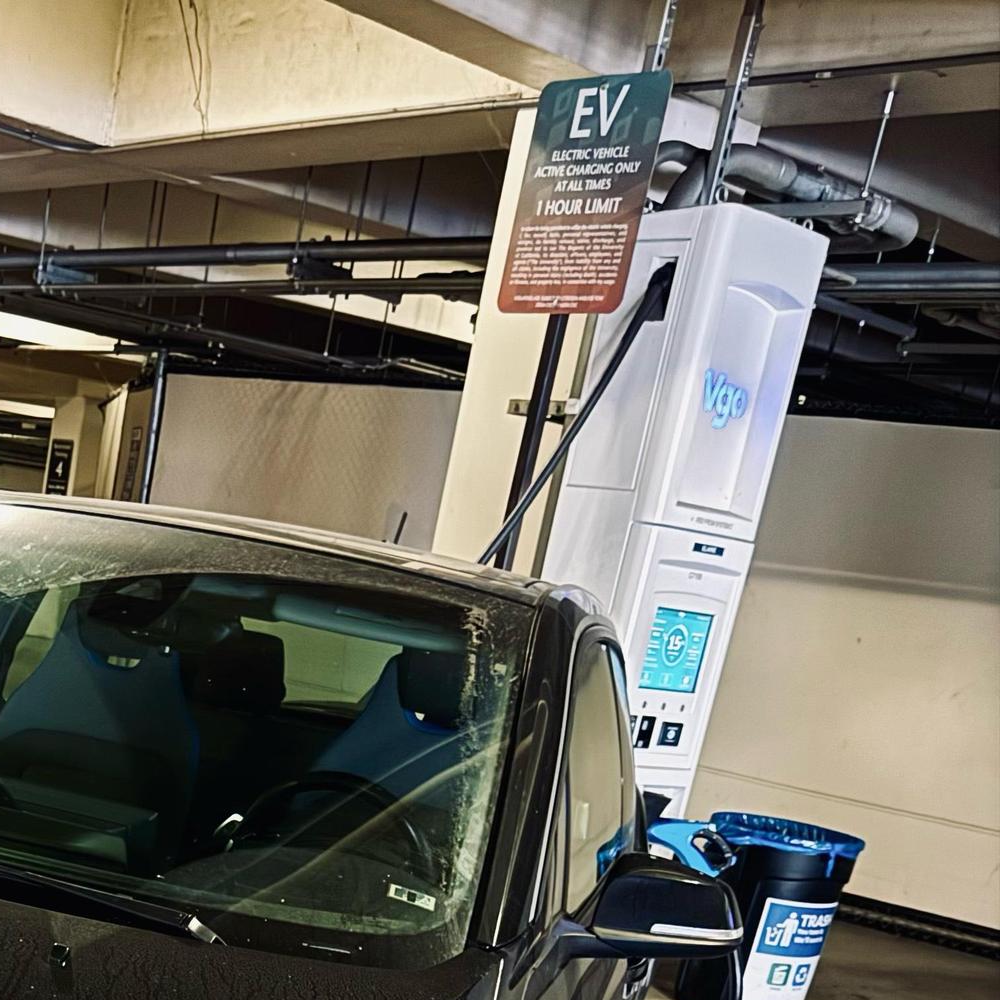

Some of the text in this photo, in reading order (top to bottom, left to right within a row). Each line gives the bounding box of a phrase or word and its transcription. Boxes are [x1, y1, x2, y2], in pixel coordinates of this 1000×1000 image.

[569, 84, 631, 139] EV
[551, 145, 630, 162] ELECTRIC VEHICLE
[534, 160, 642, 178] ACTIVE CHARGING ONLY
[554, 178, 612, 192] AT ALL TIMES
[536, 197, 623, 216] 1 HOUR LIMIT
[801, 913, 834, 928] TRAS
